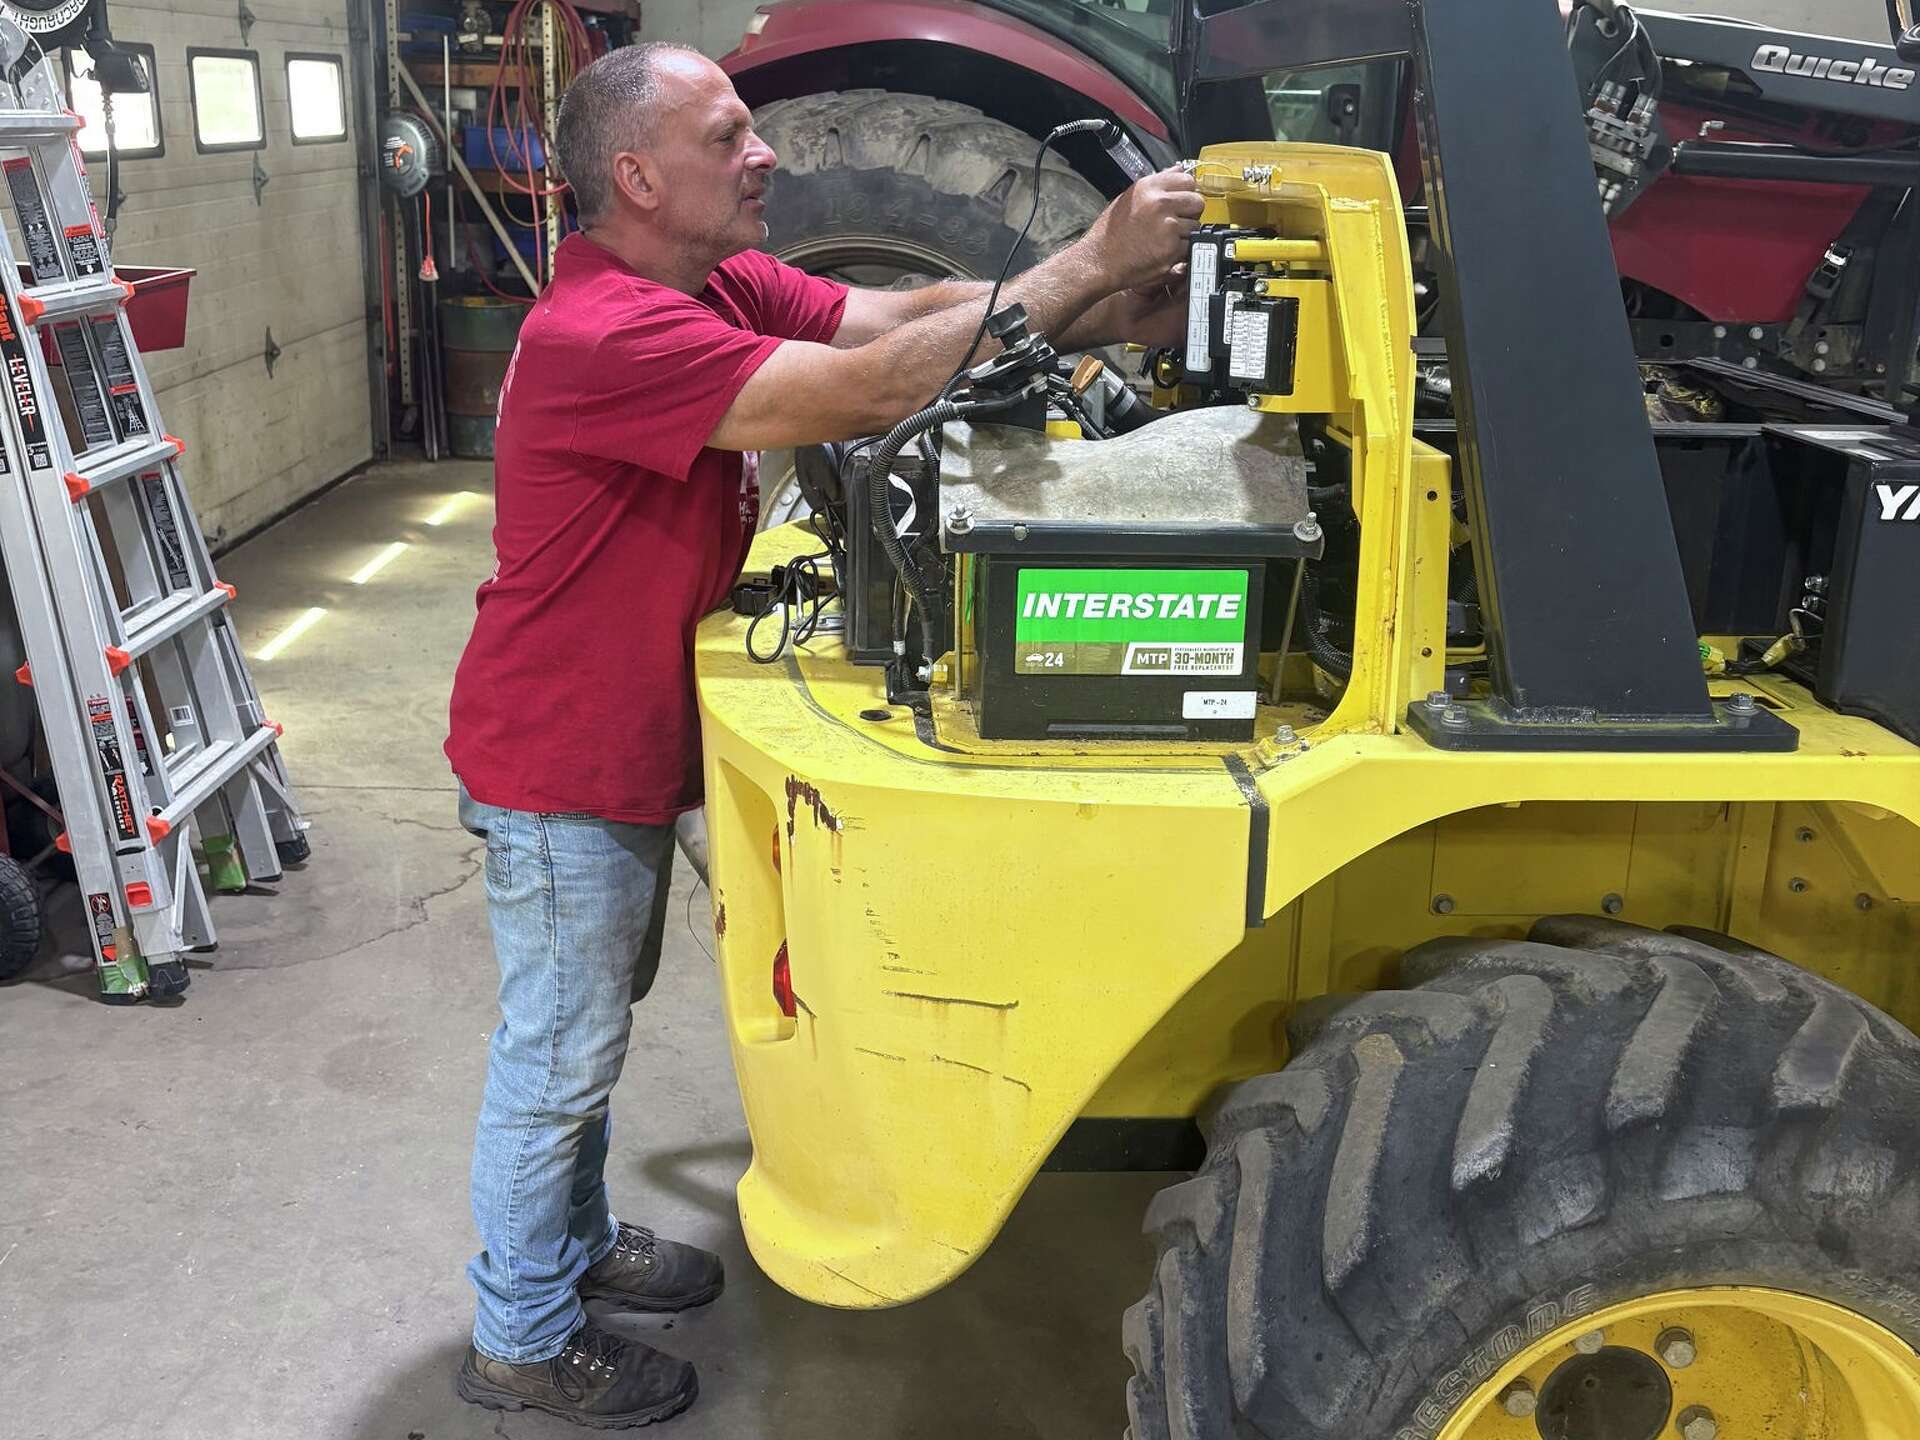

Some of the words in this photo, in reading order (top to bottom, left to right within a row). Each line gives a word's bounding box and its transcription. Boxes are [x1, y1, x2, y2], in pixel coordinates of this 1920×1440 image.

[1750, 44, 1916, 90] Quicke
[9, 357, 36, 416] LEVELER
[1022, 592, 1242, 619] INTERSTATE
[1044, 652, 1064, 667] 24
[1136, 653, 1168, 665] MTP
[1174, 652, 1234, 665] 30-MONTH
[114, 773, 136, 836] RATCHET
